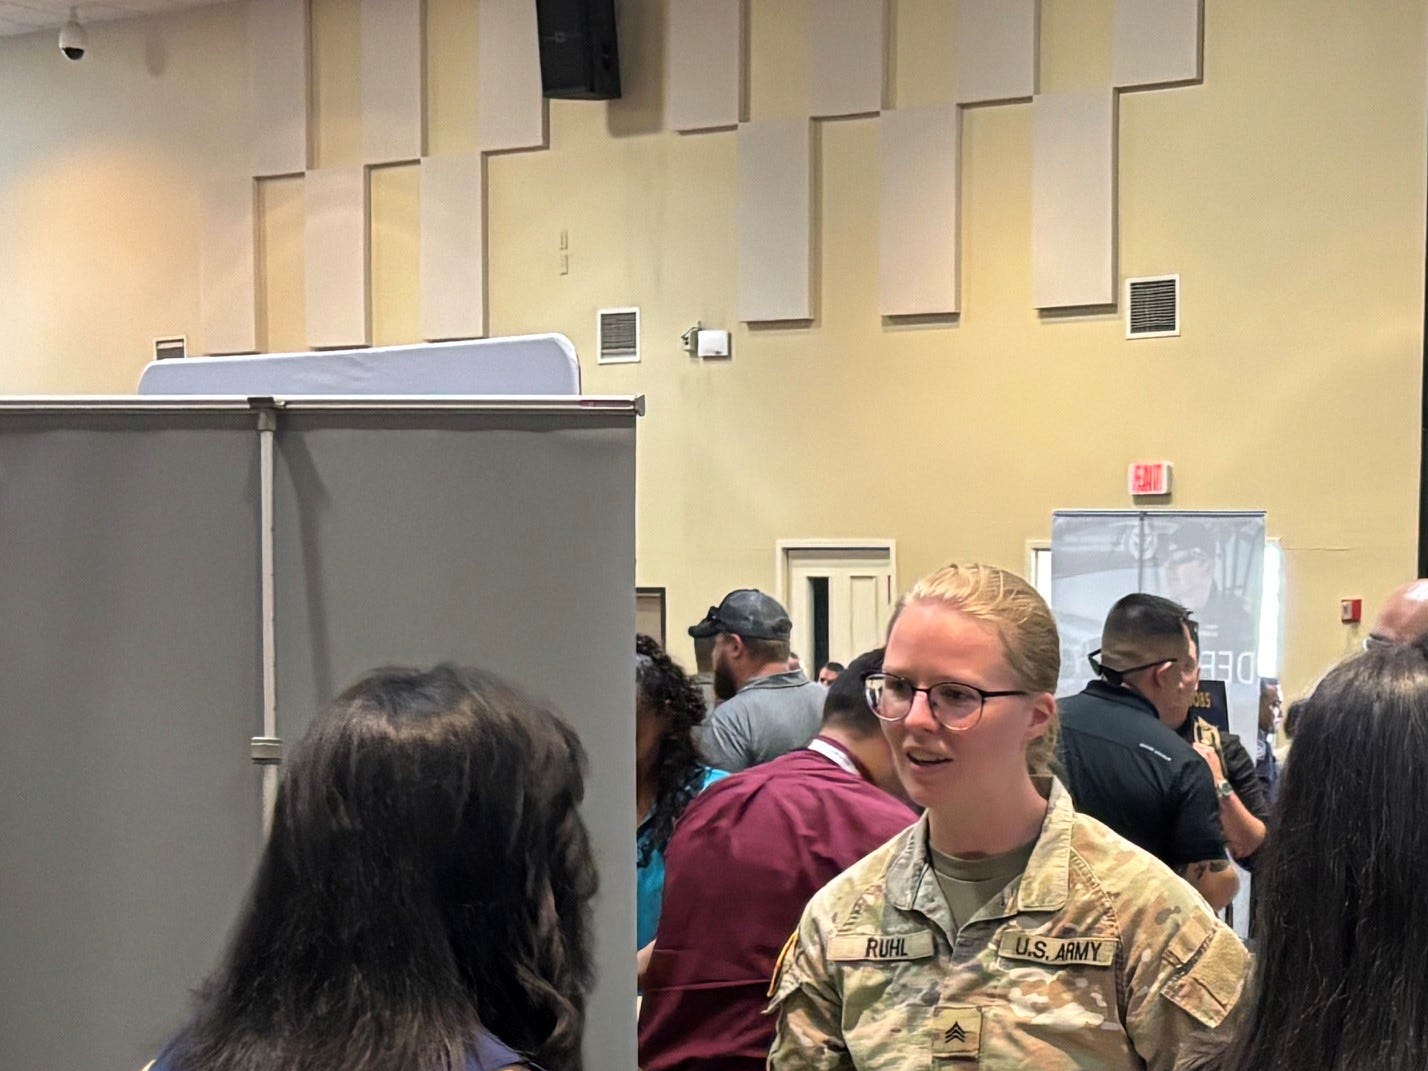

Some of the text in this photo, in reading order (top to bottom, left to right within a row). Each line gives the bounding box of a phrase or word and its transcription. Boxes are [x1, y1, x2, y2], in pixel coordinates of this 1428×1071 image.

[864, 936, 908, 958] RUHL
[1015, 937, 1102, 961] U.S. ARMY
